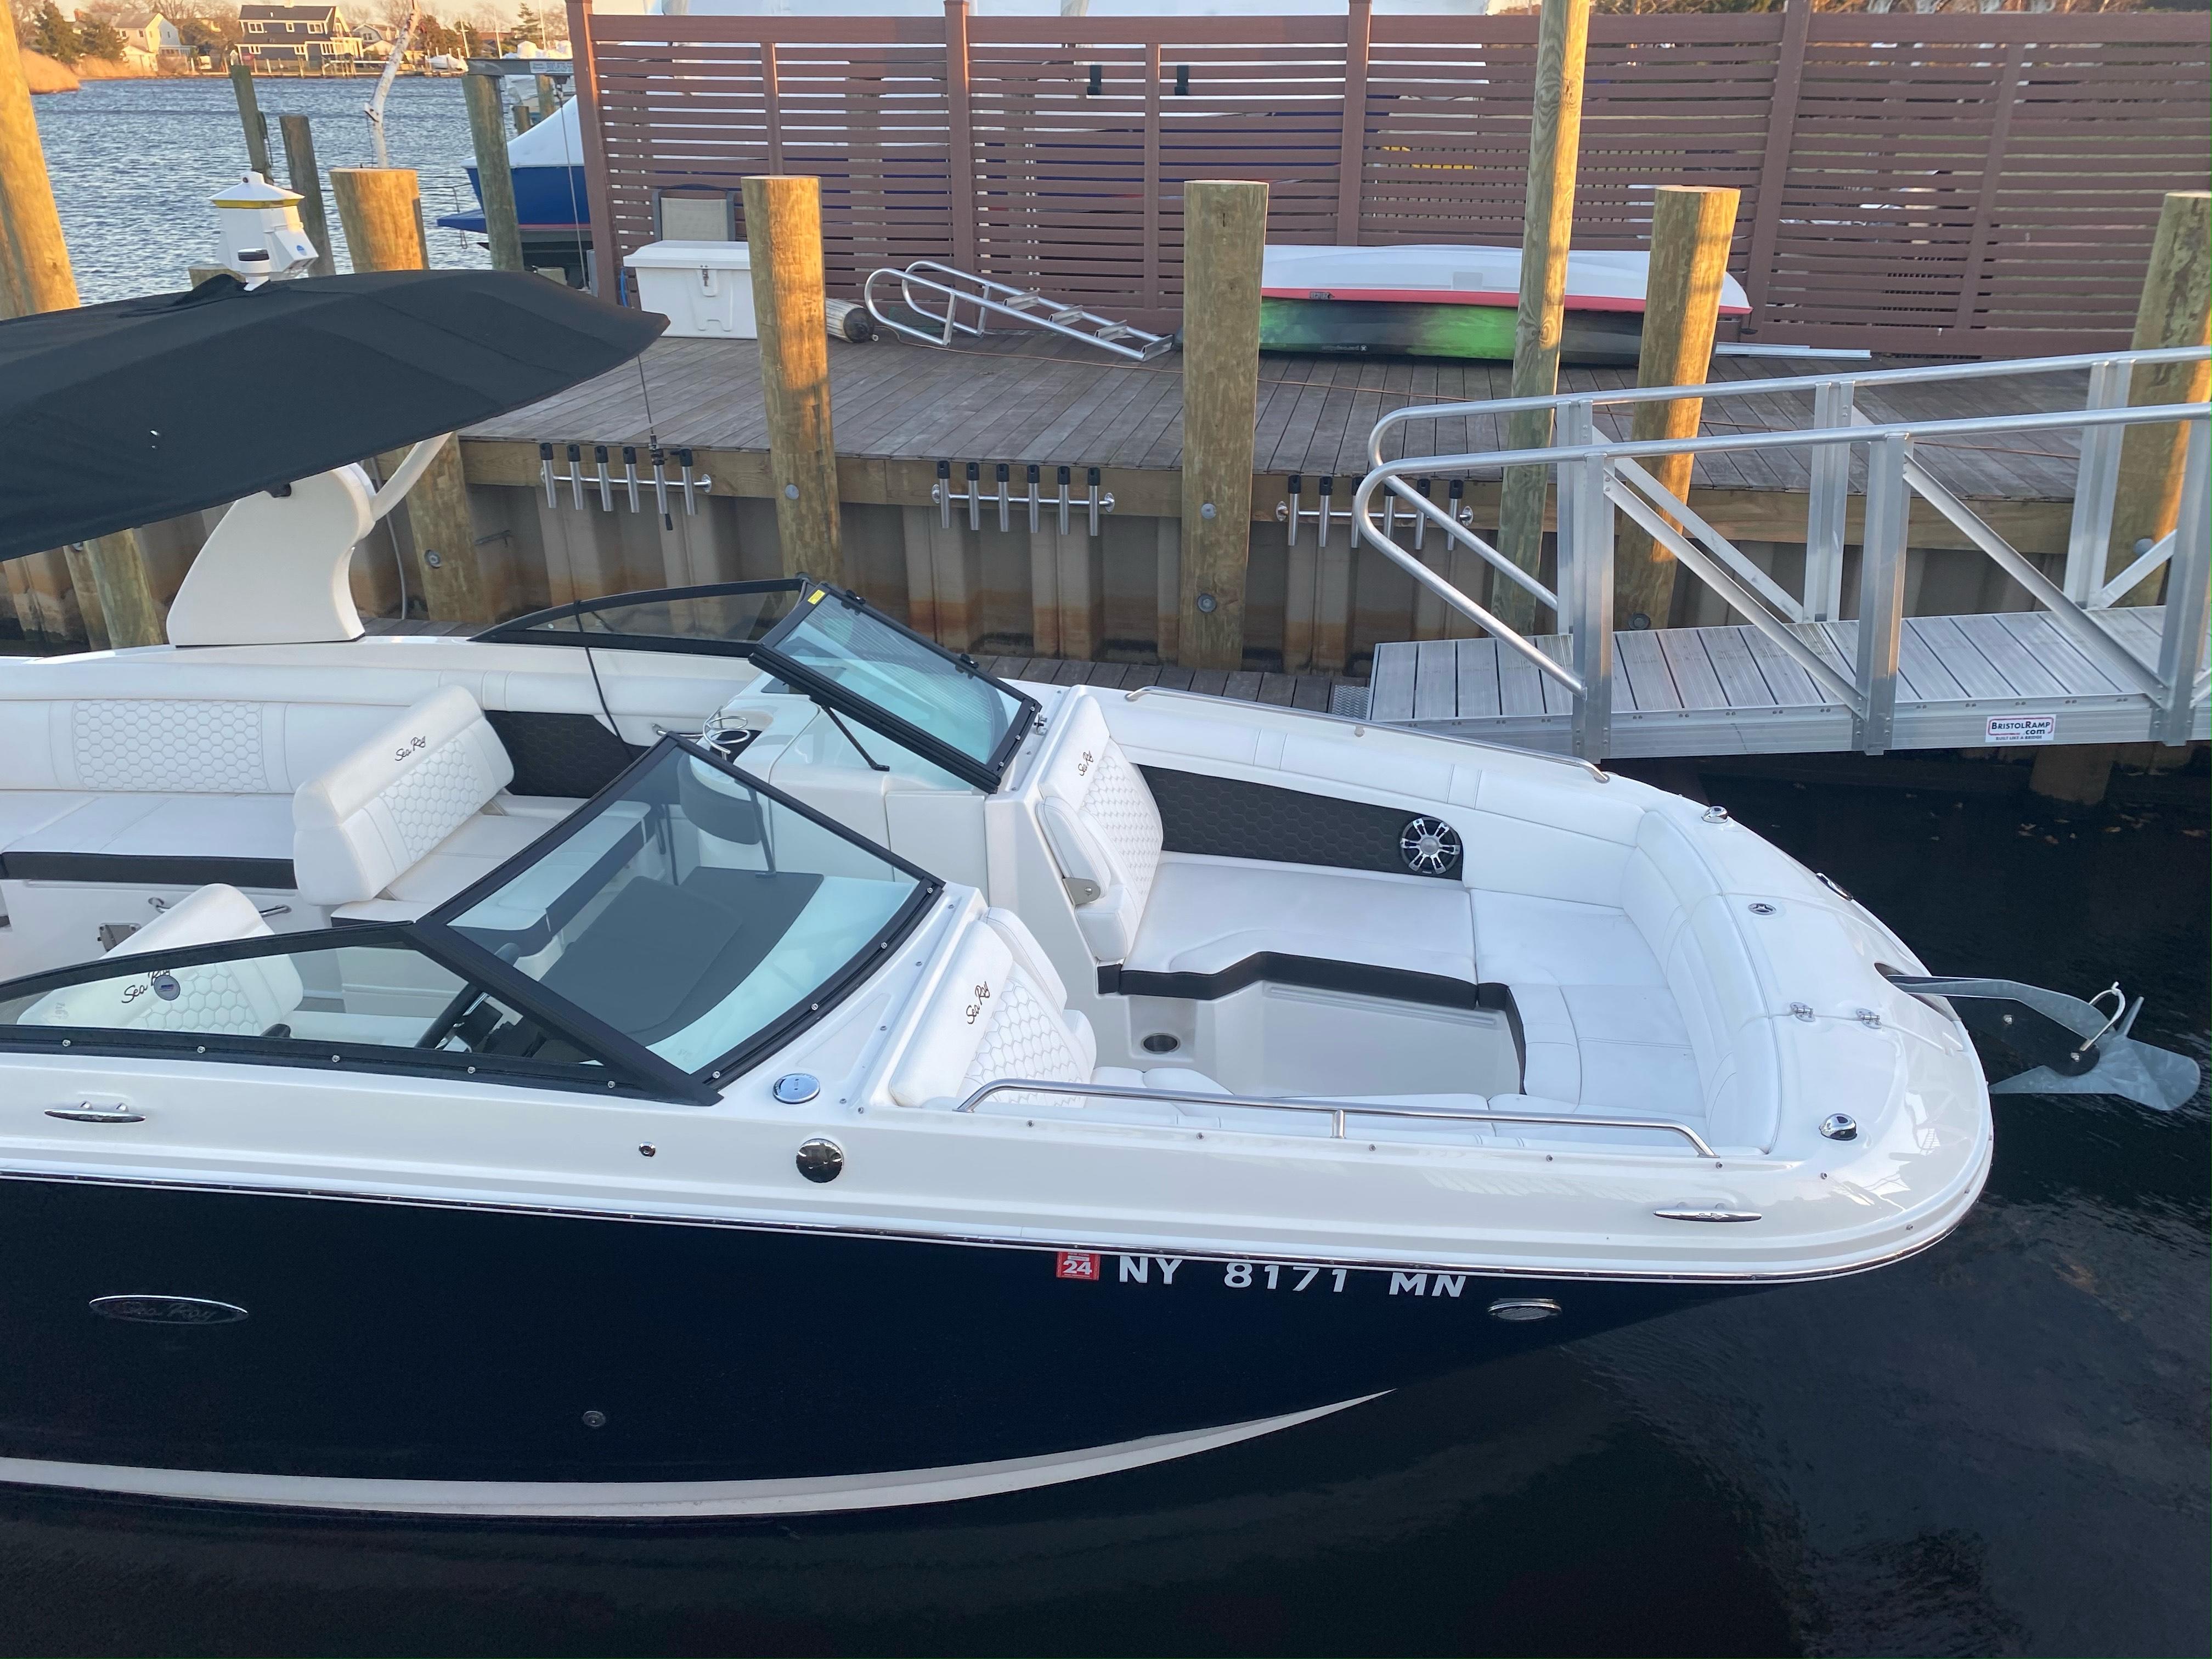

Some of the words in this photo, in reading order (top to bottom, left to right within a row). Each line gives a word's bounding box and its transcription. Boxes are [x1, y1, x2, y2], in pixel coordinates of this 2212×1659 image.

[394, 748, 411, 761] Sea
[410, 736, 426, 751] Ray
[121, 984, 148, 1003] Sea
[966, 1004, 980, 1024] Sea
[974, 980, 990, 1006] Ray
[1063, 1260, 1092, 1275] 24
[1119, 1255, 1183, 1284] NY
[1224, 1262, 1347, 1292] 8171
[1389, 1272, 1466, 1297] MN
